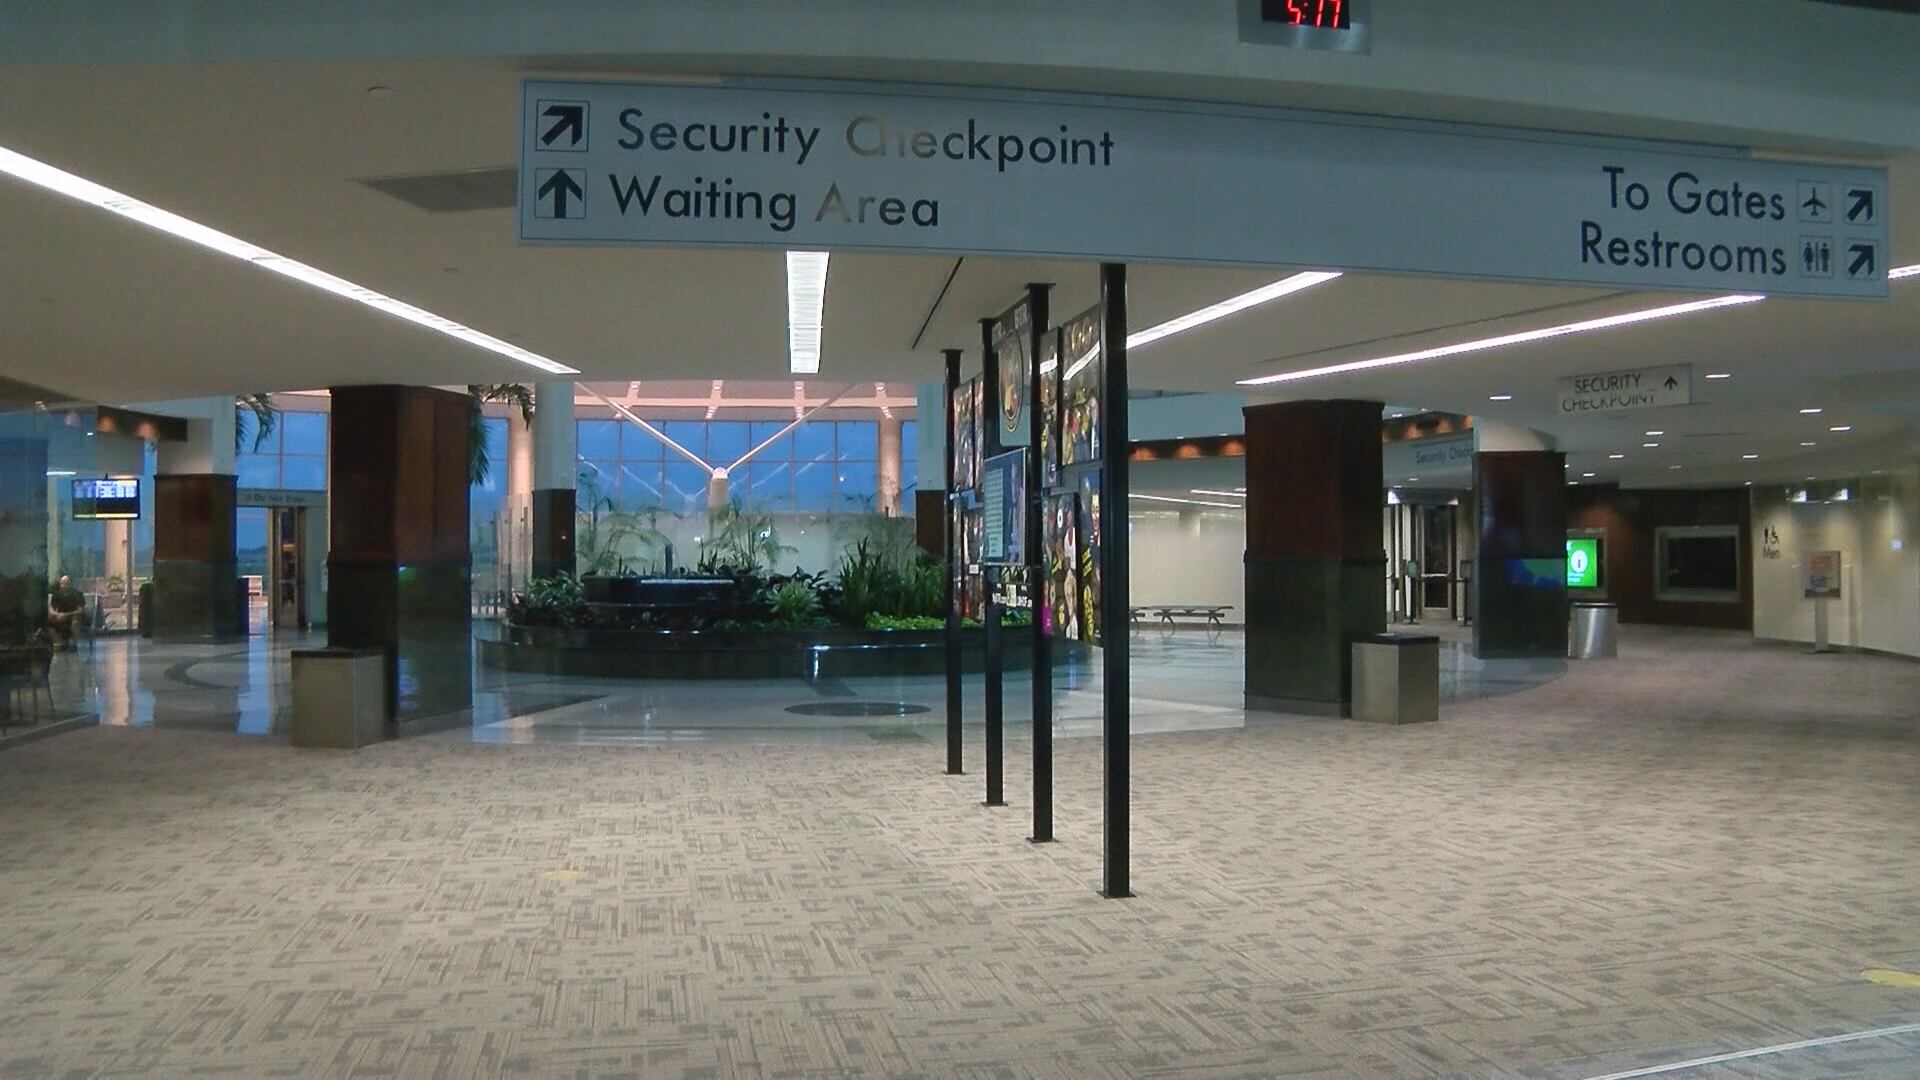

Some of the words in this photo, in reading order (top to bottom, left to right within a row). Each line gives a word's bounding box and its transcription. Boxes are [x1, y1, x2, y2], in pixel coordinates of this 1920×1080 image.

[1286, 0, 1344, 29] 5:17
[618, 108, 820, 164] Security
[846, 114, 1115, 172] Checkpoint
[609, 173, 797, 233] Waiting
[815, 182, 940, 227] Area
[1602, 166, 1649, 211] To
[1667, 171, 1785, 221] Gates
[1581, 221, 1787, 276] Restrooms
[1562, 389, 1656, 412] CHECKPOINT
[1574, 373, 1641, 394] SECURITY
